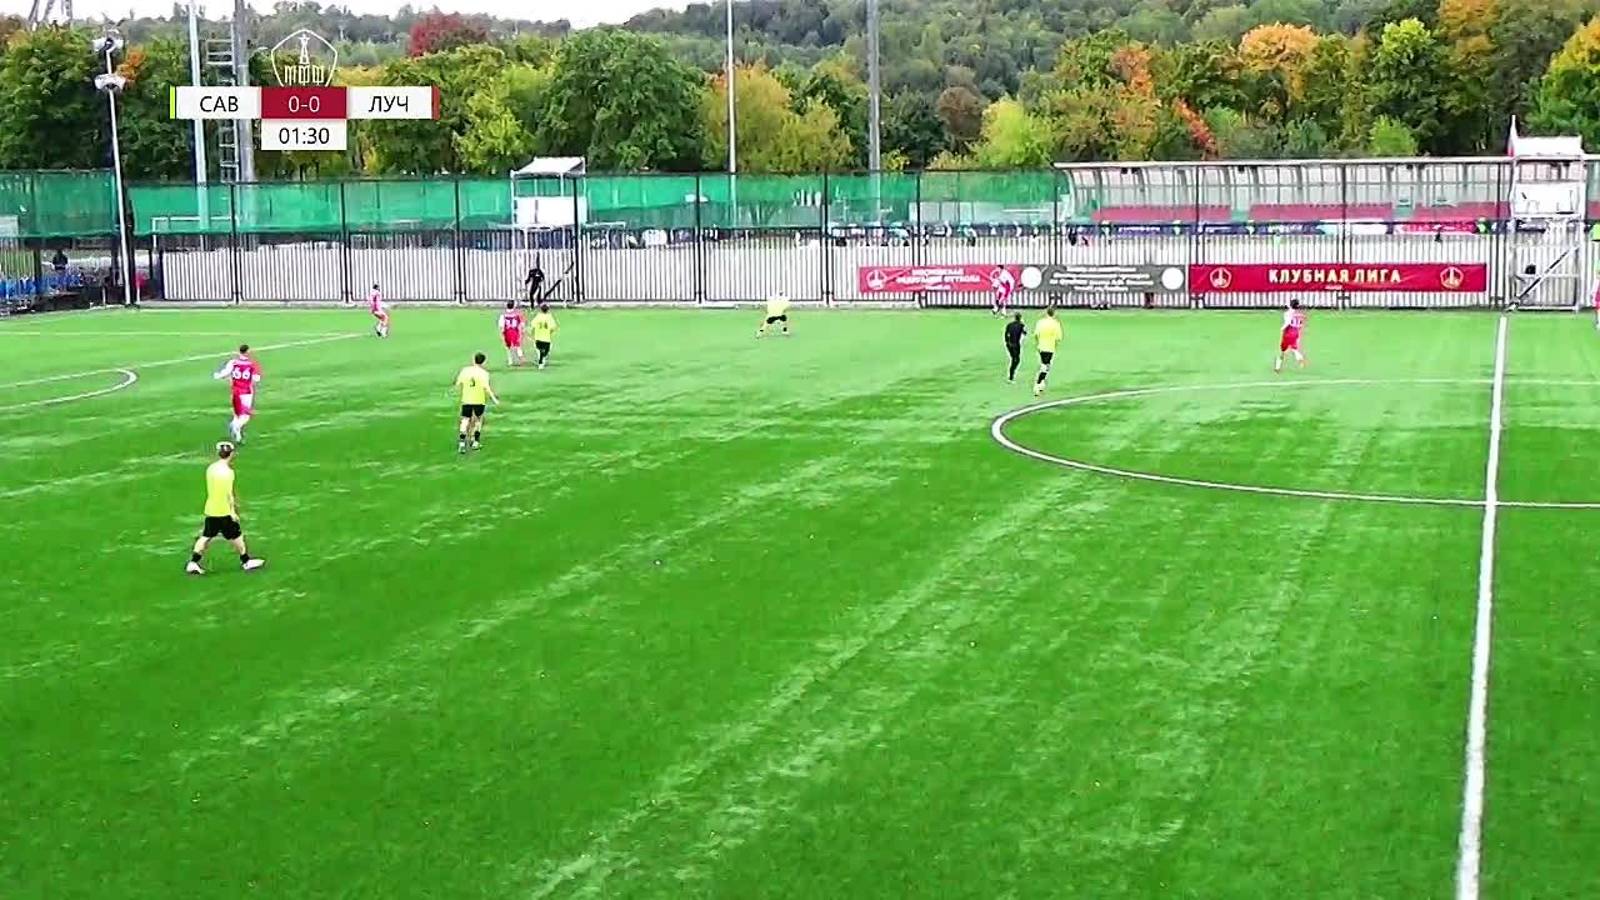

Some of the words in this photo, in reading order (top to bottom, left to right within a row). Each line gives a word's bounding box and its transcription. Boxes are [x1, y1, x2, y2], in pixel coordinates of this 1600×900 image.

[1268, 269, 1350, 284] КЛУБНАЯ
[1353, 269, 1402, 284] ЛИГА
[232, 366, 251, 380] 66
